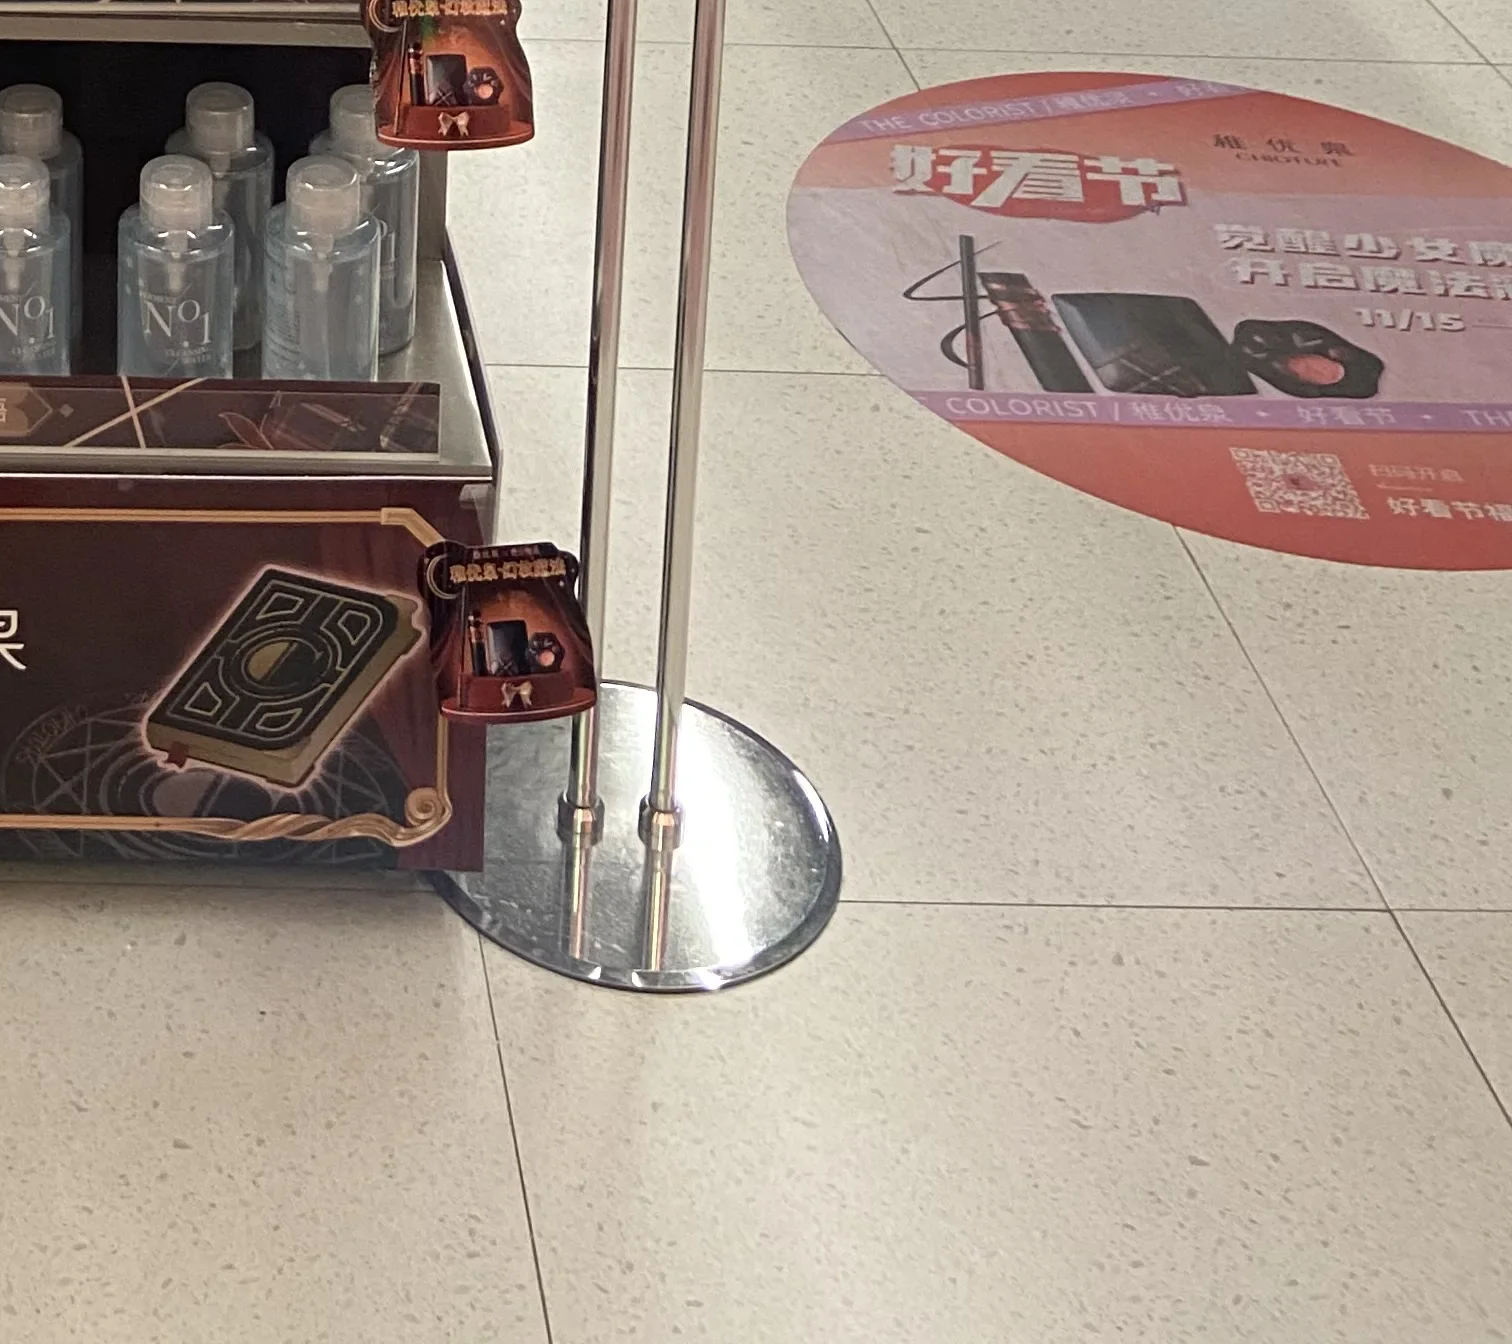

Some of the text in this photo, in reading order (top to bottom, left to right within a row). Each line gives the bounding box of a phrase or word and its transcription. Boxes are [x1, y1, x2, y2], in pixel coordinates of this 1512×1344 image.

[859, 115, 911, 133] THE
[917, 98, 1039, 128] COLORIST
[890, 143, 1188, 209] 好看节
[1355, 307, 1467, 333] 11/15
[945, 395, 1099, 419] COLORIST
[1296, 404, 1398, 426] 好看节
